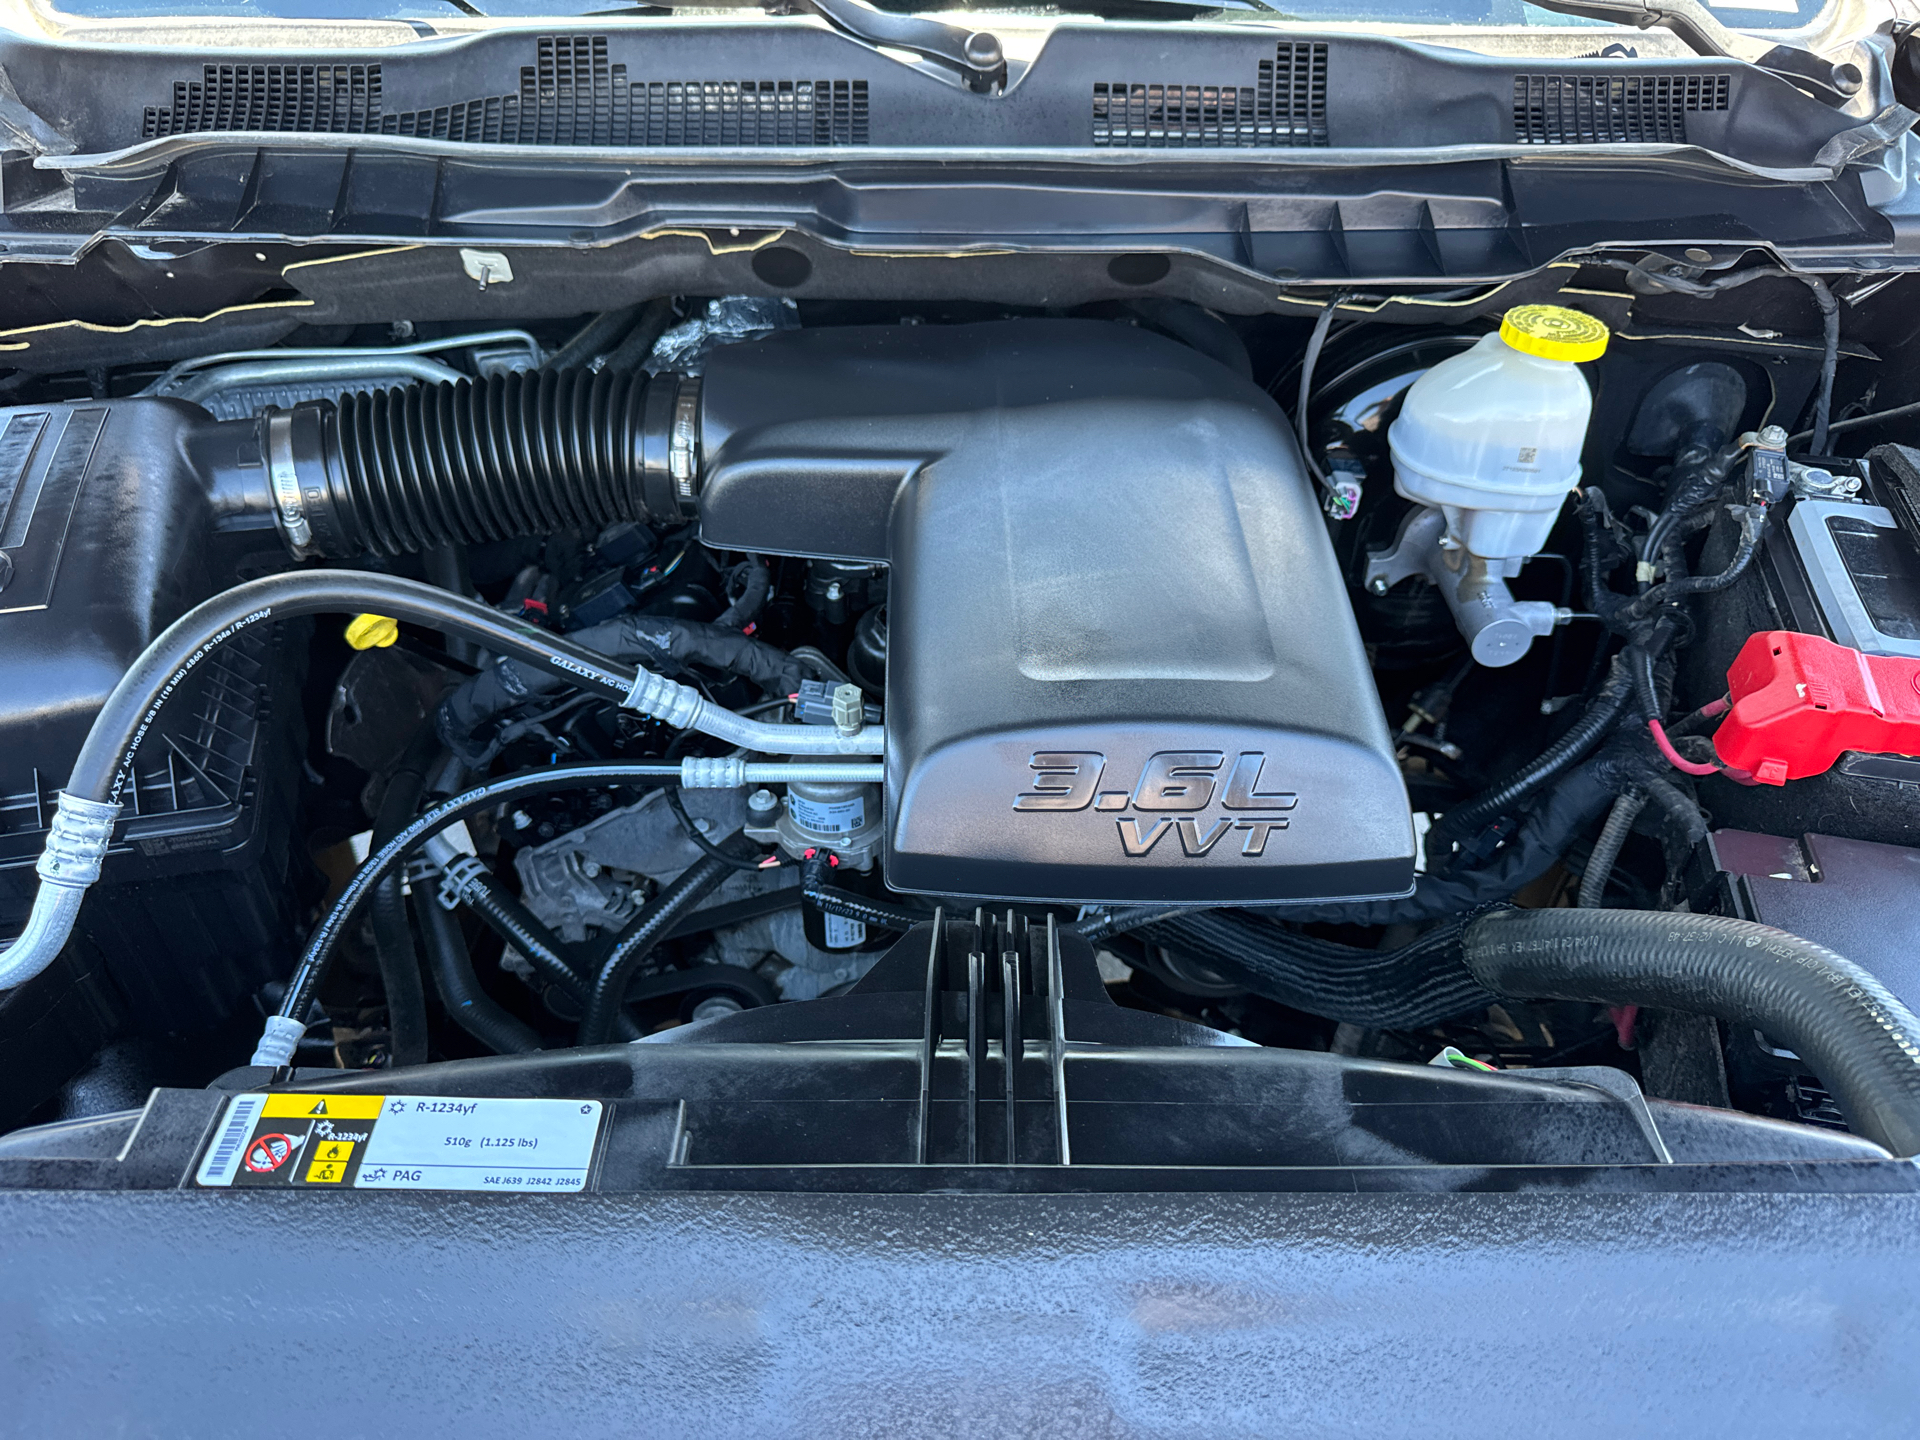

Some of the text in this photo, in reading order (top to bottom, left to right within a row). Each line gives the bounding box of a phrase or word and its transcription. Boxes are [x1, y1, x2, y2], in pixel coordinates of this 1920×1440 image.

[550, 656, 634, 693] GALAXY A/C HOS
[108, 769, 126, 805] LAXY
[123, 751, 135, 767] A/C
[130, 724, 148, 750] HOSE
[145, 709, 157, 724] 5/8
[154, 698, 164, 710] IN
[161, 684, 173, 700] (16
[170, 668, 188, 687] MM)
[186, 650, 204, 670] 4860
[203, 629, 232, 652] R-134a
[235, 608, 272, 630] R-1234yf
[1012, 750, 1299, 812] 3.6L
[441, 786, 487, 813] GALAXY
[395, 829, 408, 843] A/C
[1116, 817, 1290, 859] VVT
[377, 840, 398, 859] HOSE
[416, 1101, 477, 1116] R-1234yf
[327, 1132, 369, 1143] R-1234yf
[444, 1136, 539, 1149] 510g (1.125 lbs)
[392, 1170, 422, 1182] PAG
[483, 1176, 582, 1186] SAE J639 J2842 J2845
